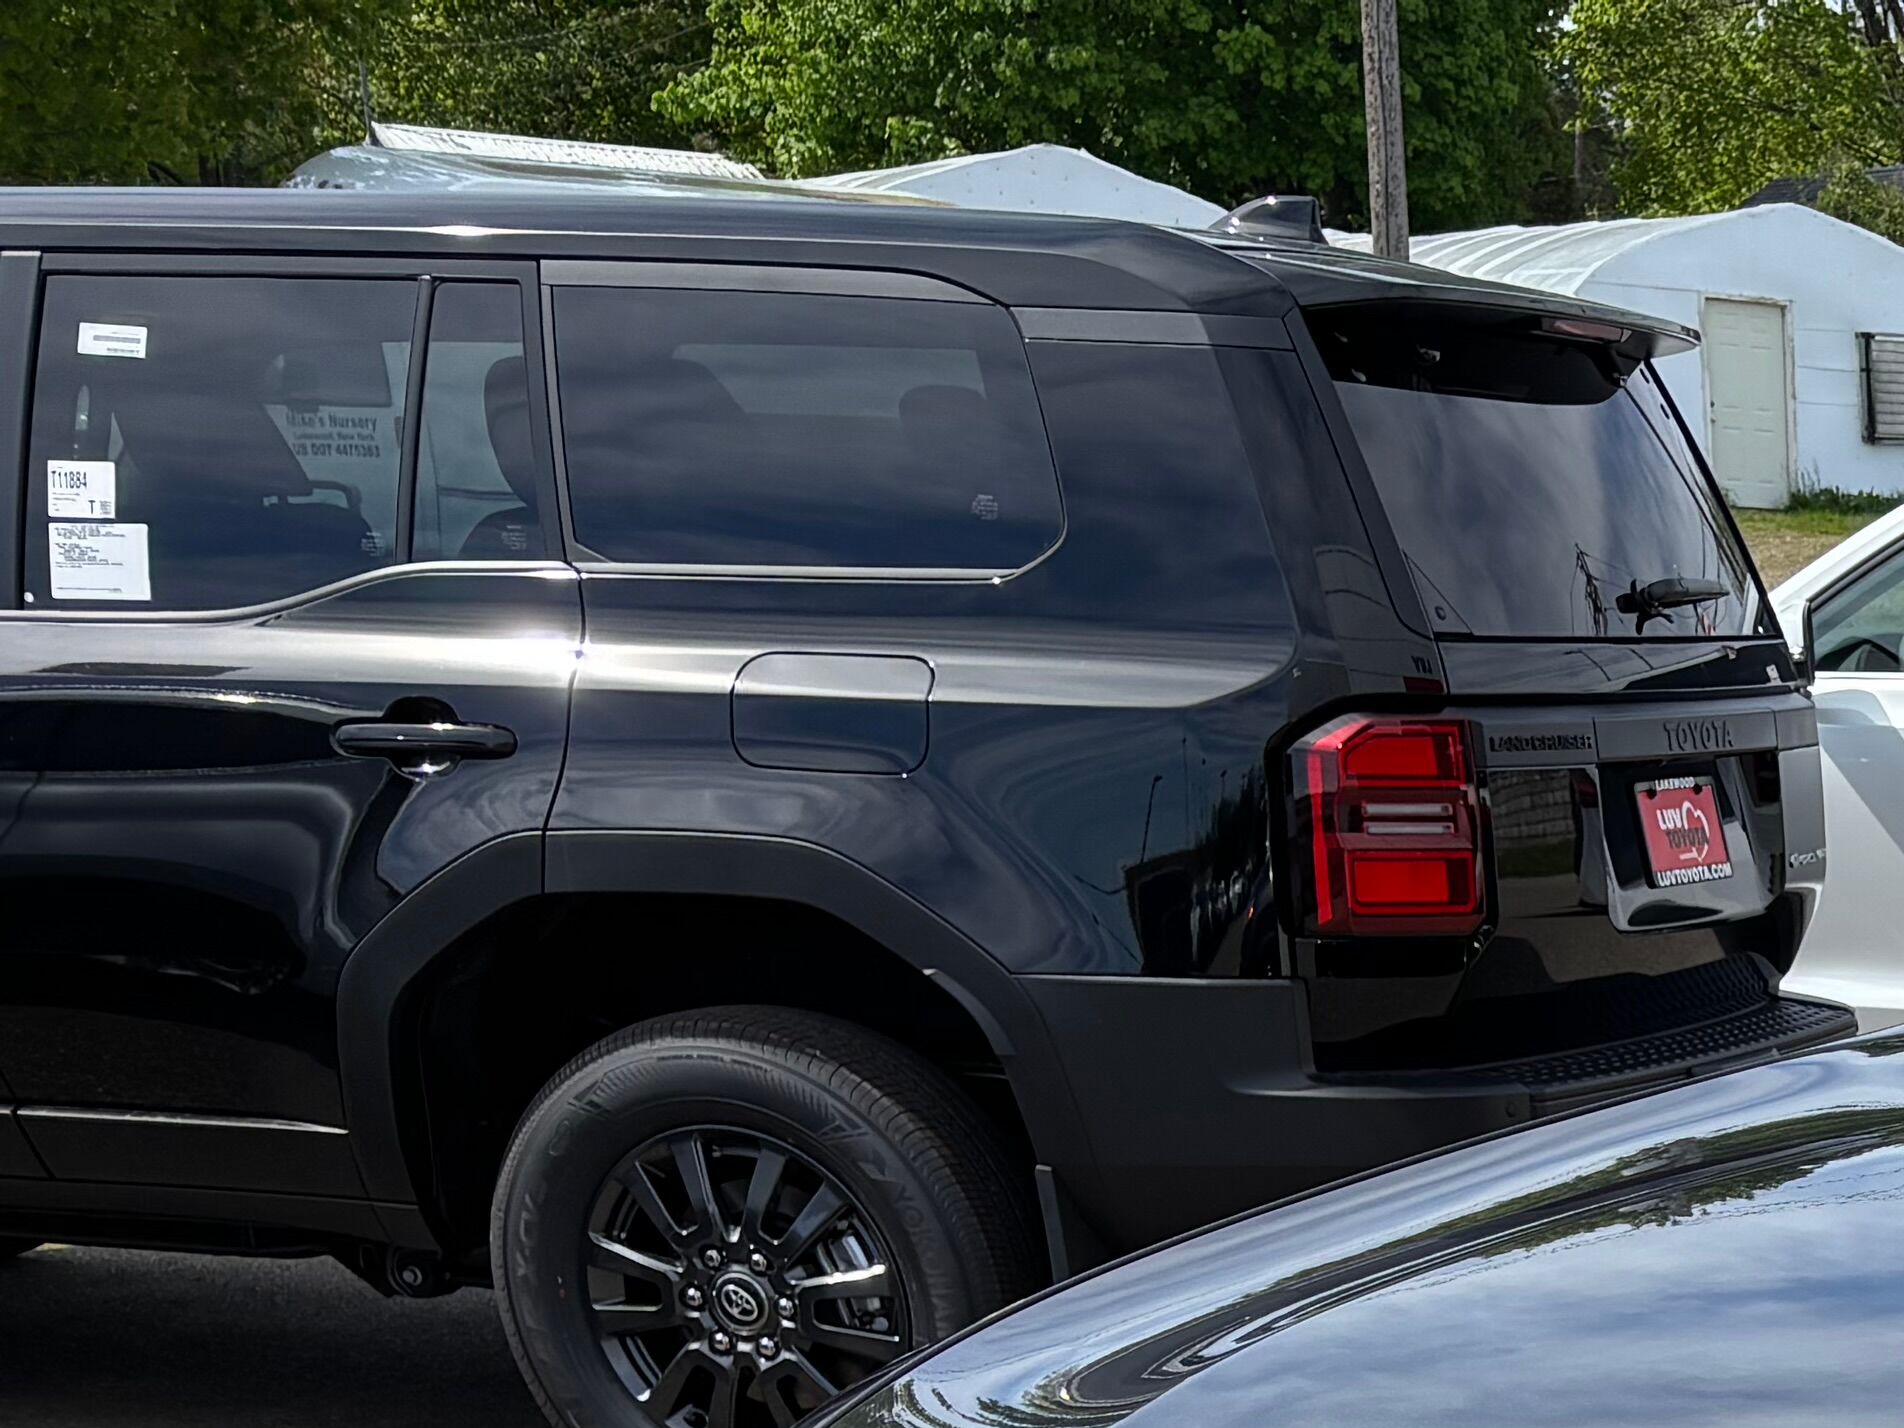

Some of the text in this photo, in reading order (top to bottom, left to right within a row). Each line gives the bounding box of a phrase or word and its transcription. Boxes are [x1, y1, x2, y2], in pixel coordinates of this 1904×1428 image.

[1663, 719, 1734, 752] TOYOTA
[1654, 776, 1696, 791] LAKEWOOD
[1655, 808, 1684, 831] LUV
[1665, 826, 1710, 850] TOYOTA
[1656, 862, 1733, 888] LUVTOYOTA.COM
